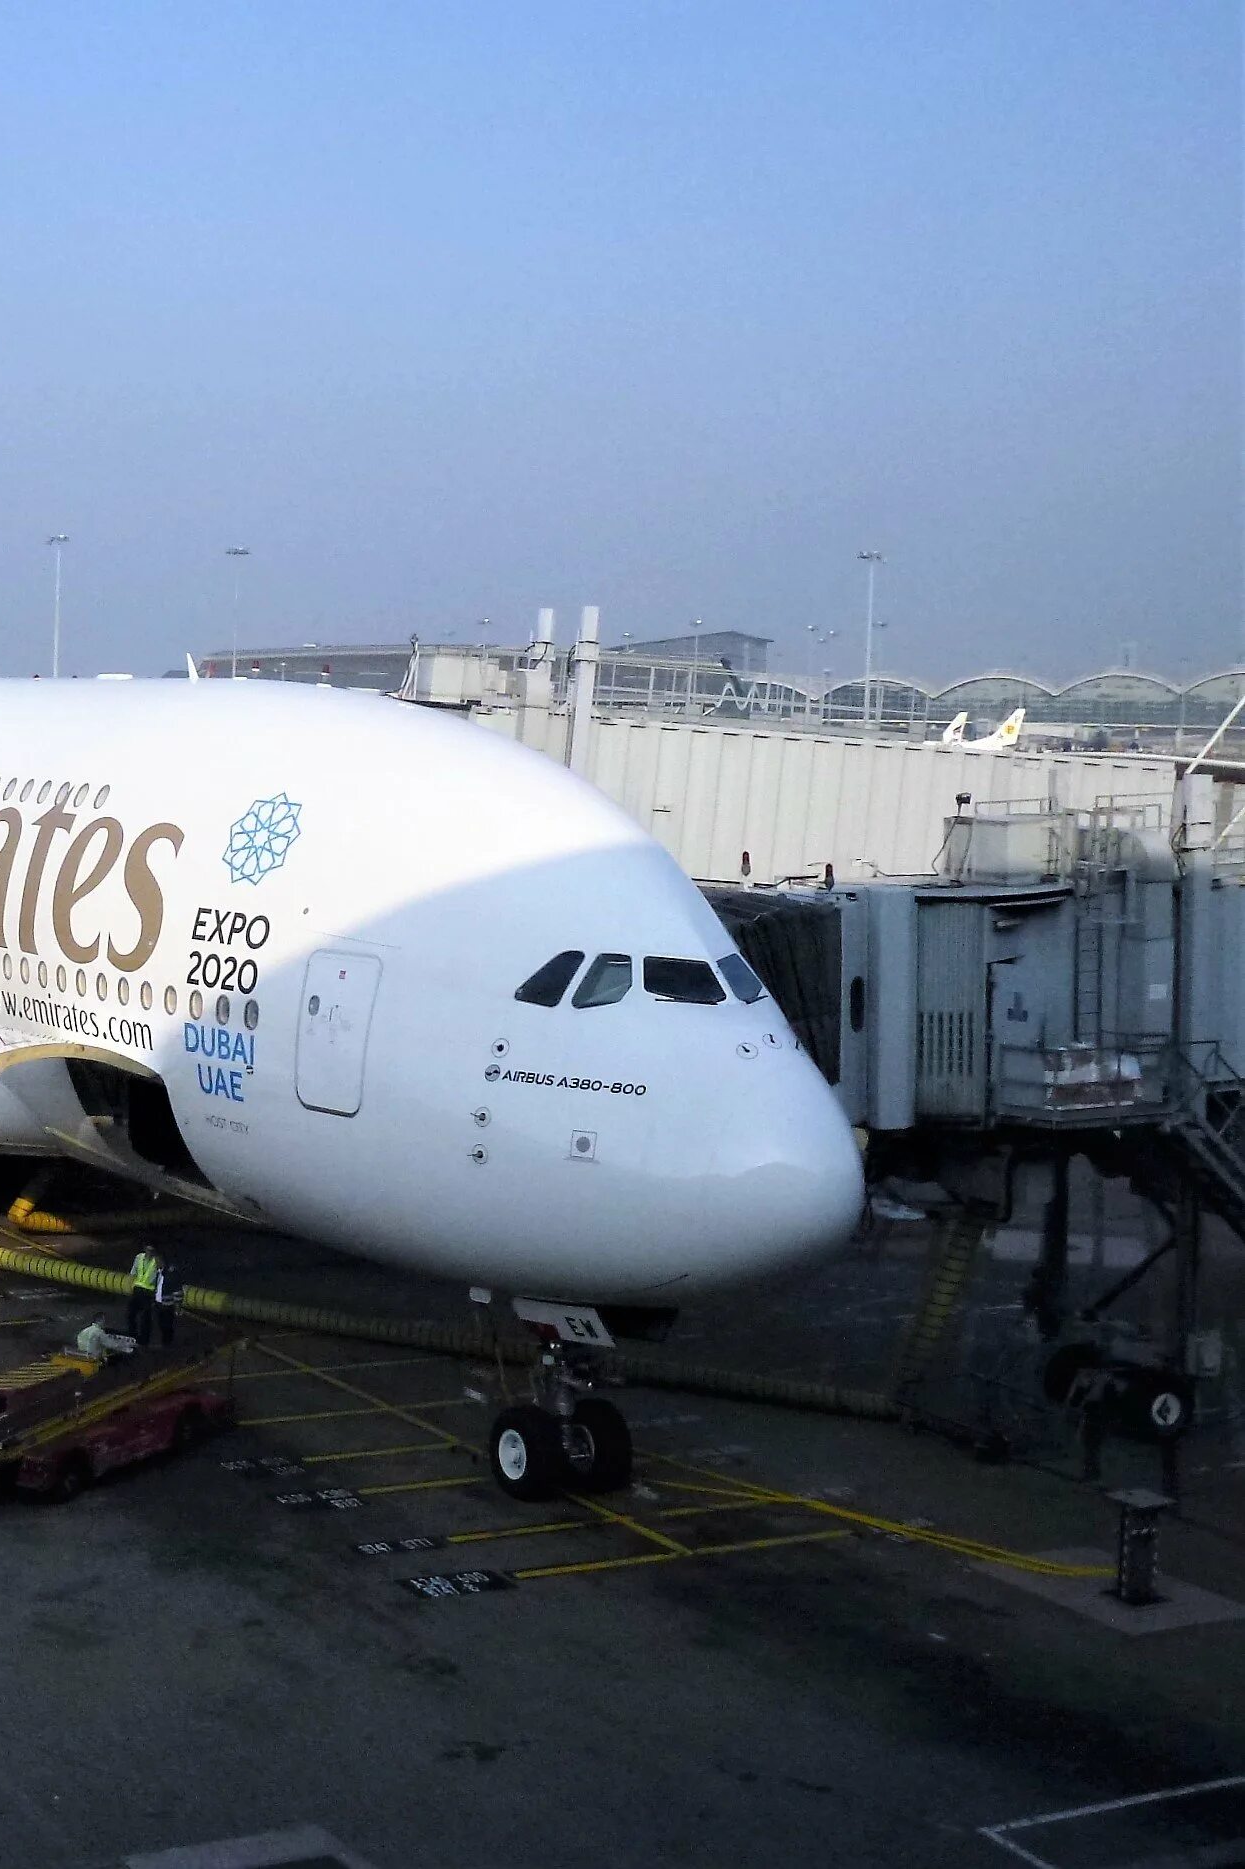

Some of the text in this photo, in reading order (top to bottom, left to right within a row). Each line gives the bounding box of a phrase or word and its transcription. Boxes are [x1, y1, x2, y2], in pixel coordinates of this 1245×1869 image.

[191, 907, 270, 950] EXPO
[186, 951, 258, 995] 2020
[184, 1022, 255, 1066] DUBAI
[197, 1063, 244, 1102] UAE
[502, 1070, 647, 1096] AIRBUS A380-800
